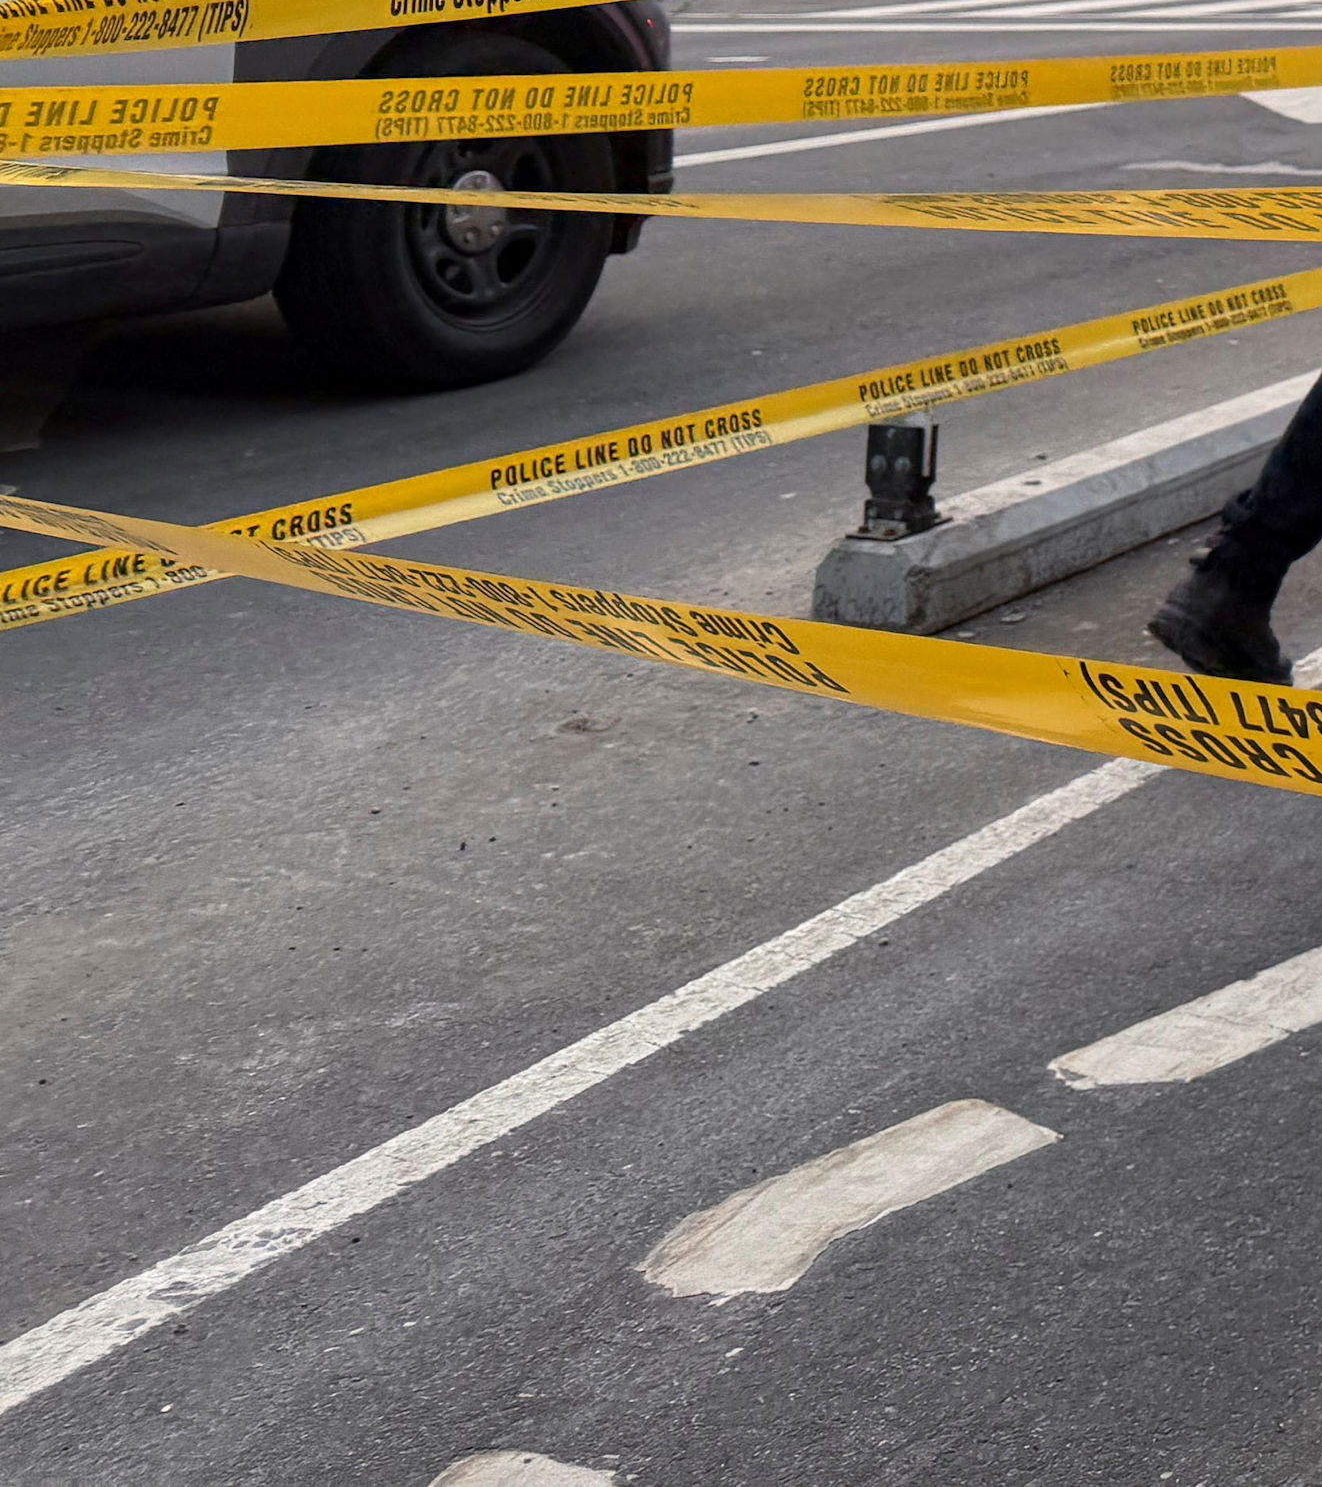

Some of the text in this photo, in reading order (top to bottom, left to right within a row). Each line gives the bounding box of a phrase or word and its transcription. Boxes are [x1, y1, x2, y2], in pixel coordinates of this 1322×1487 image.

[17, 22, 81, 55] Stoppers
[80, 4, 199, 46] 1-800-222-8477
[1132, 311, 1176, 335] POLICE
[1180, 303, 1203, 325] LINE
[859, 338, 1062, 402] POLICE LINE DO NOT CROSS
[491, 409, 763, 490] POLICE LINE DO NOT CROSS
[497, 431, 773, 506] Crime Stoppers 1-800-222-8477 (TIPS)
[271, 503, 353, 541] CROSS
[84, 553, 147, 586] LINE
[50, 581, 144, 614] Stoppers
[550, 590, 698, 637] Stoppers
[505, 607, 582, 641] DO
[566, 618, 684, 661] LINE
[689, 610, 799, 656] Crime
[668, 637, 850, 693] POLICE
[1080, 660, 1215, 726] (TIPS)
